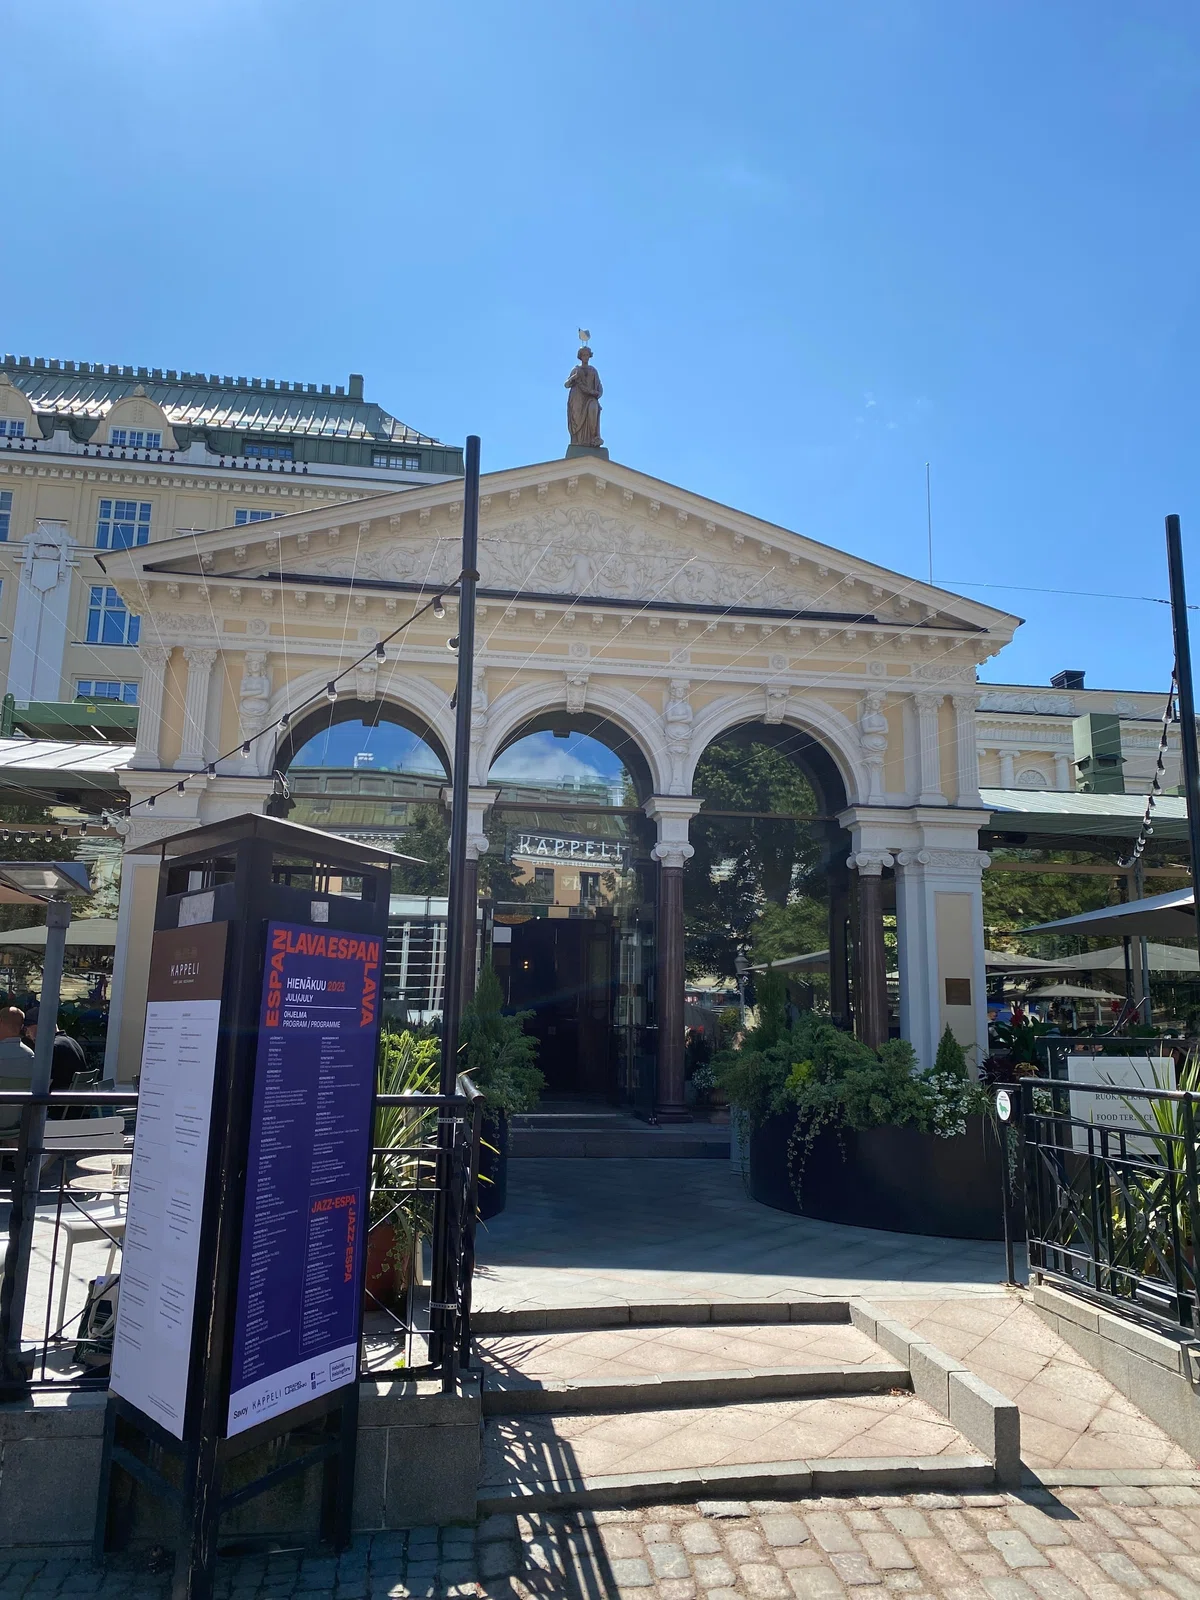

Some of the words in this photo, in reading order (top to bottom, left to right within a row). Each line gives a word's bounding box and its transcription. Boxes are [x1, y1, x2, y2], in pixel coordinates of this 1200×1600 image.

[520, 836, 620, 858] KAPPELI
[286, 931, 326, 957] LAVA
[327, 936, 379, 962] ESPAN
[170, 962, 200, 977] KAPPELI
[265, 929, 287, 1027] ESPAN
[360, 961, 378, 1028] LAVA
[283, 1010, 308, 1019] OHJELMA
[311, 1194, 357, 1214] JAZZ-ESPA
[343, 1207, 356, 1283] JAZZ-ESPA
[252, 1389, 282, 1410] KAPPELI
